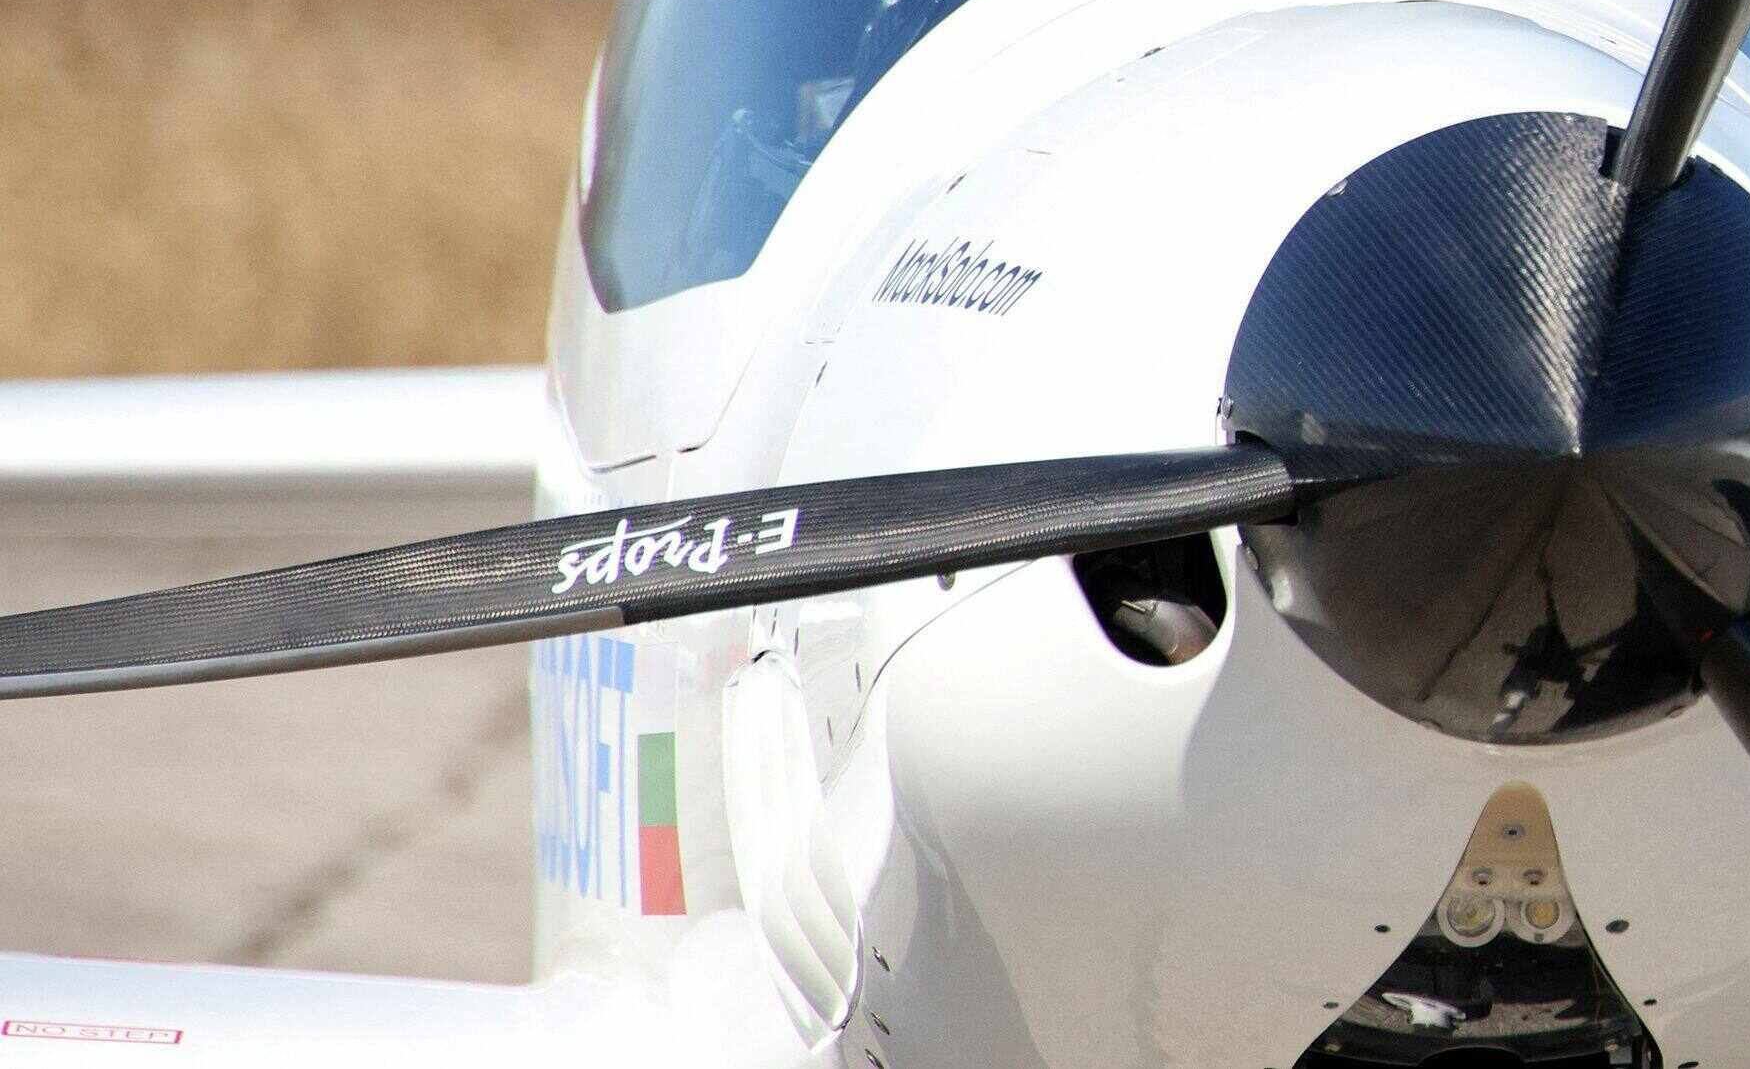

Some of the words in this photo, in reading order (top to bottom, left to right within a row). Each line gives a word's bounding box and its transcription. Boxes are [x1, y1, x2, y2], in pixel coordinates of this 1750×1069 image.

[872, 236, 1043, 316] MackSolo.com
[551, 508, 799, 595] E-Props
[16, 1023, 66, 1034] NO
[79, 1028, 169, 1040] STEP
